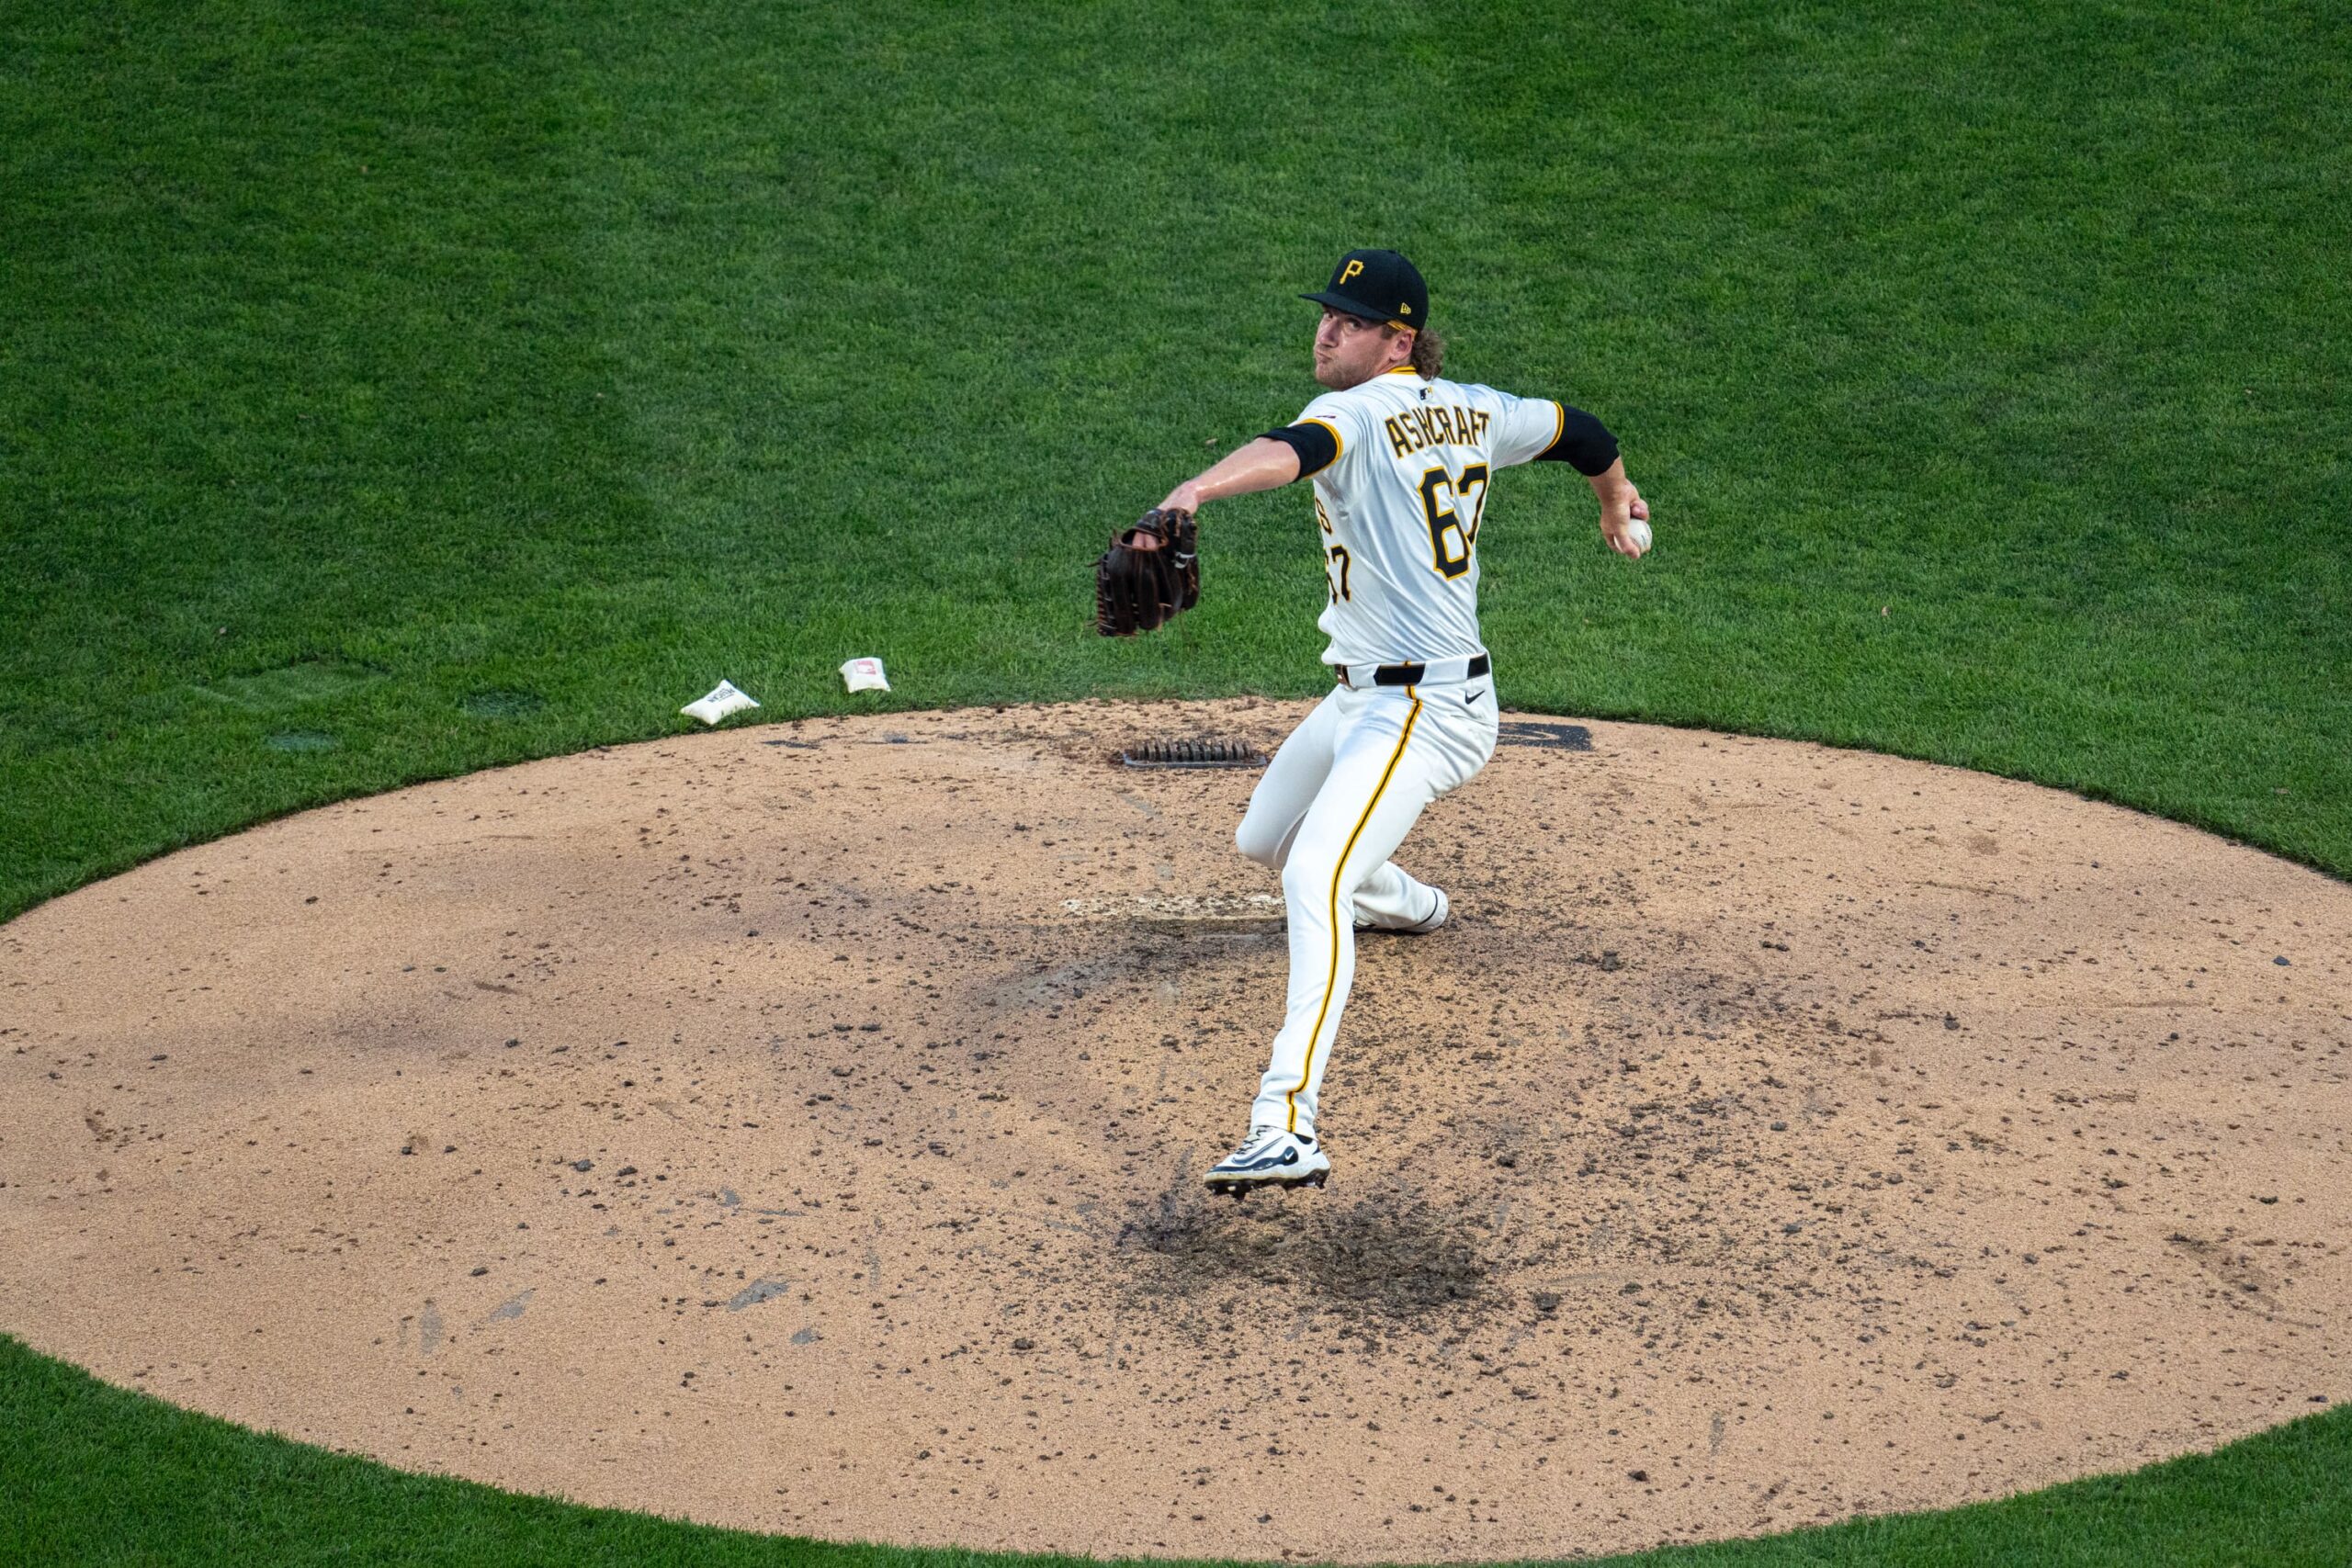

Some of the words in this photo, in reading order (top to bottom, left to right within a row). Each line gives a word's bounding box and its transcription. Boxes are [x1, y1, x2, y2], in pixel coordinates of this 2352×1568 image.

[1340, 259, 1364, 285] P
[1385, 405, 1490, 458] ASHCRAFT
[1418, 462, 1489, 581] 67
